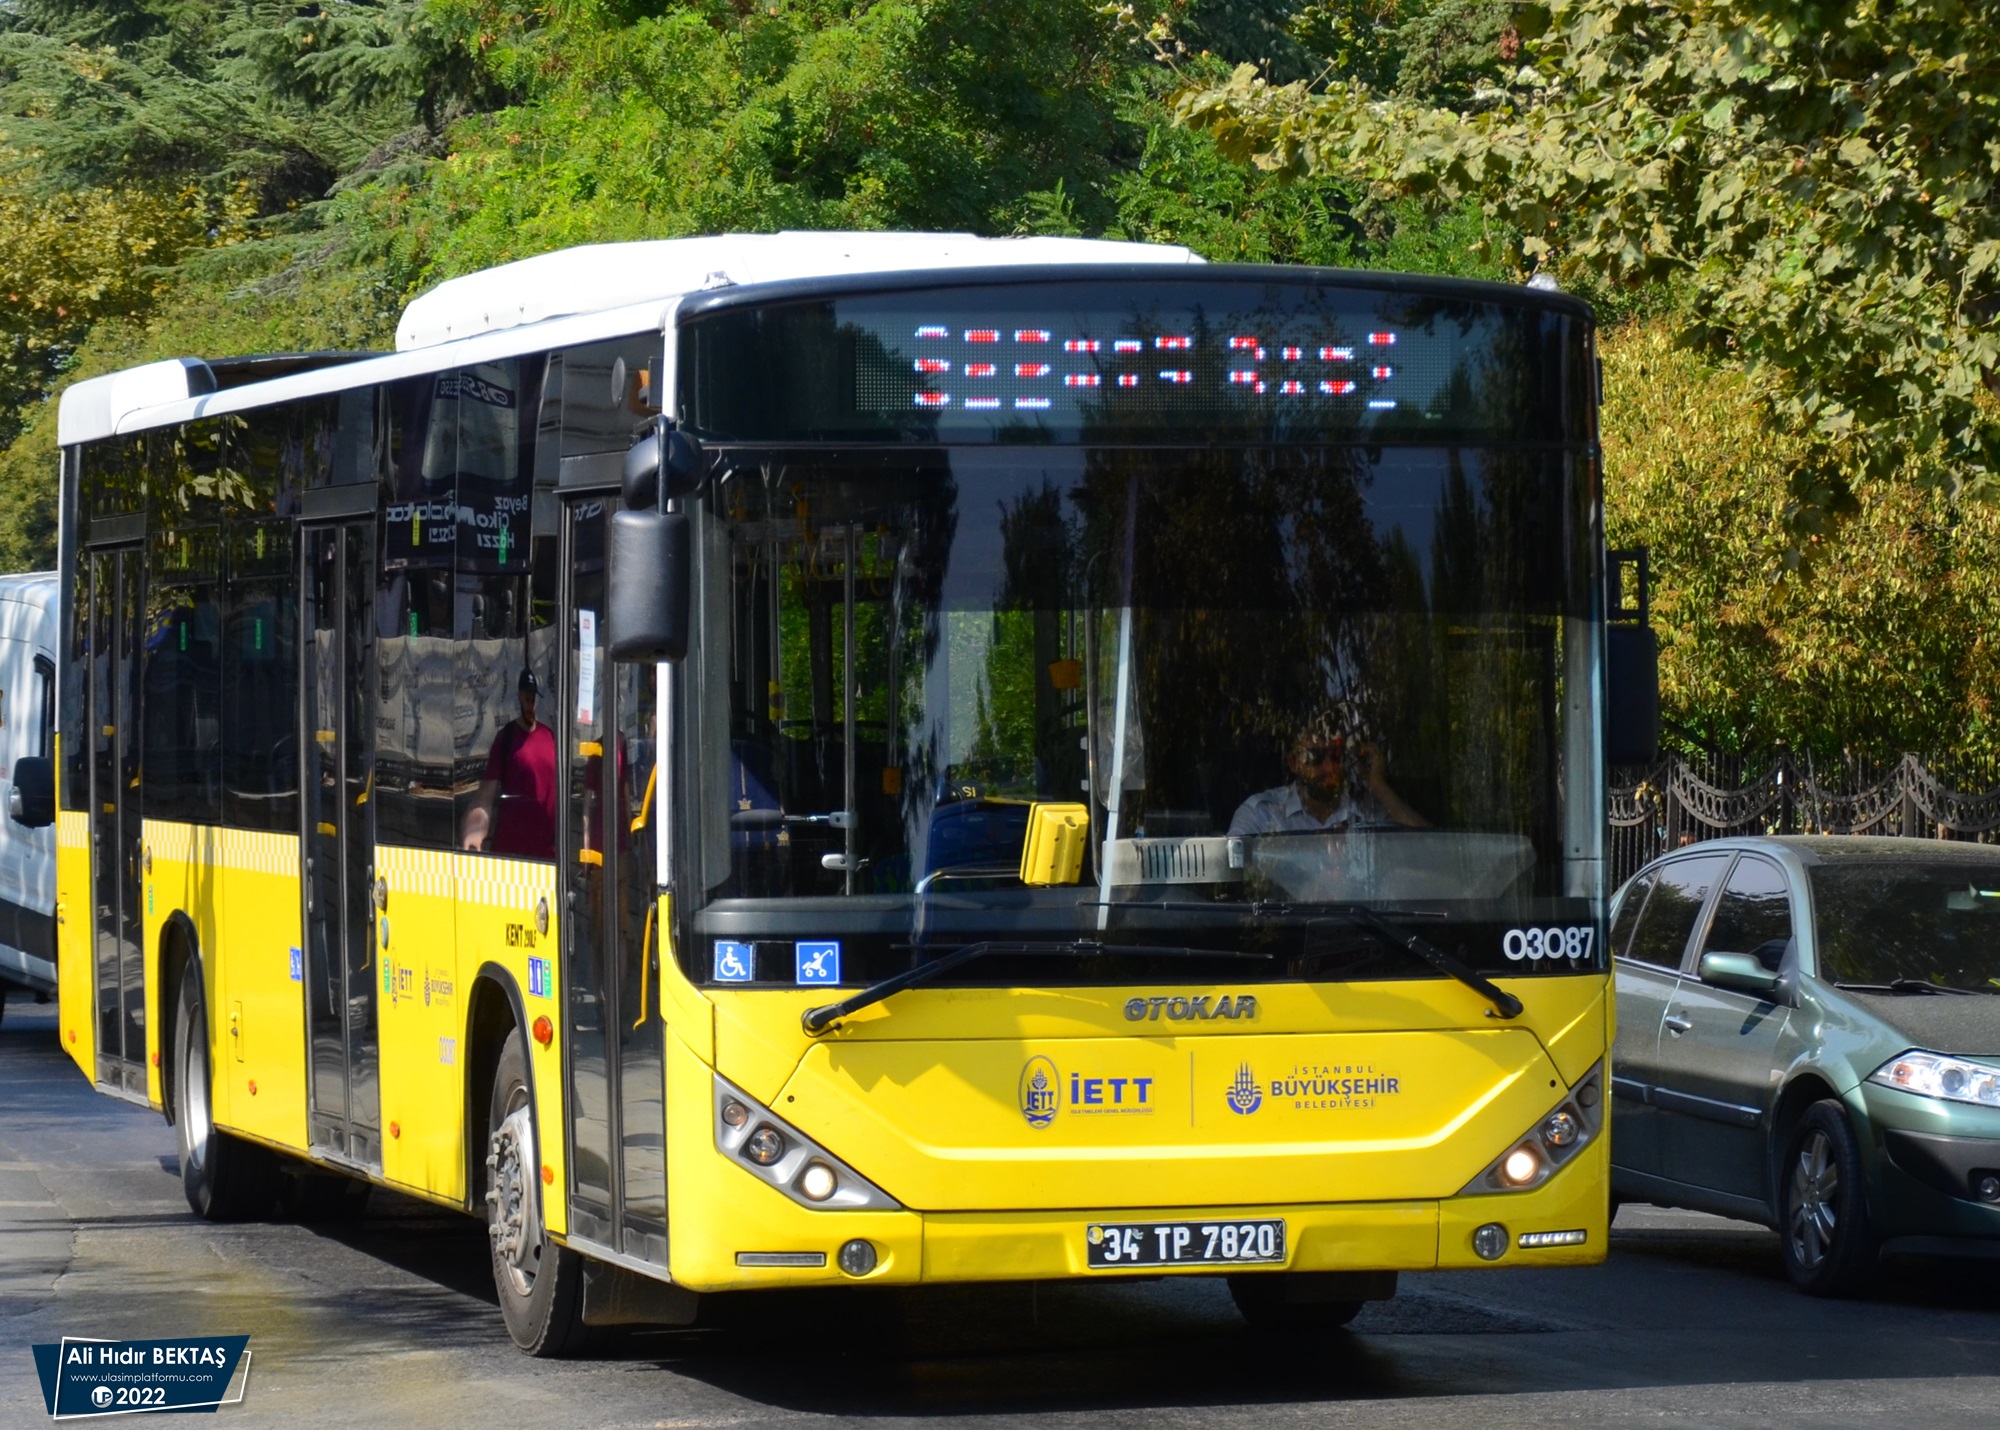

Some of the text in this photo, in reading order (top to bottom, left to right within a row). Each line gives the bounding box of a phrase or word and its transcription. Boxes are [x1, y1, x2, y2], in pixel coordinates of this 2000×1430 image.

[505, 923, 523, 948] KENT
[1503, 927, 1594, 960] 03087
[1123, 995, 1257, 1021] OTOKAR
[1294, 1065, 1374, 1076] İSTANBUL
[1071, 1073, 1153, 1104] İETT
[1271, 1073, 1399, 1099] BÜYÜKŞEHİR
[1295, 1097, 1374, 1109] BELEDİYESİ
[1103, 1224, 1275, 1261] 34 TP 7820
